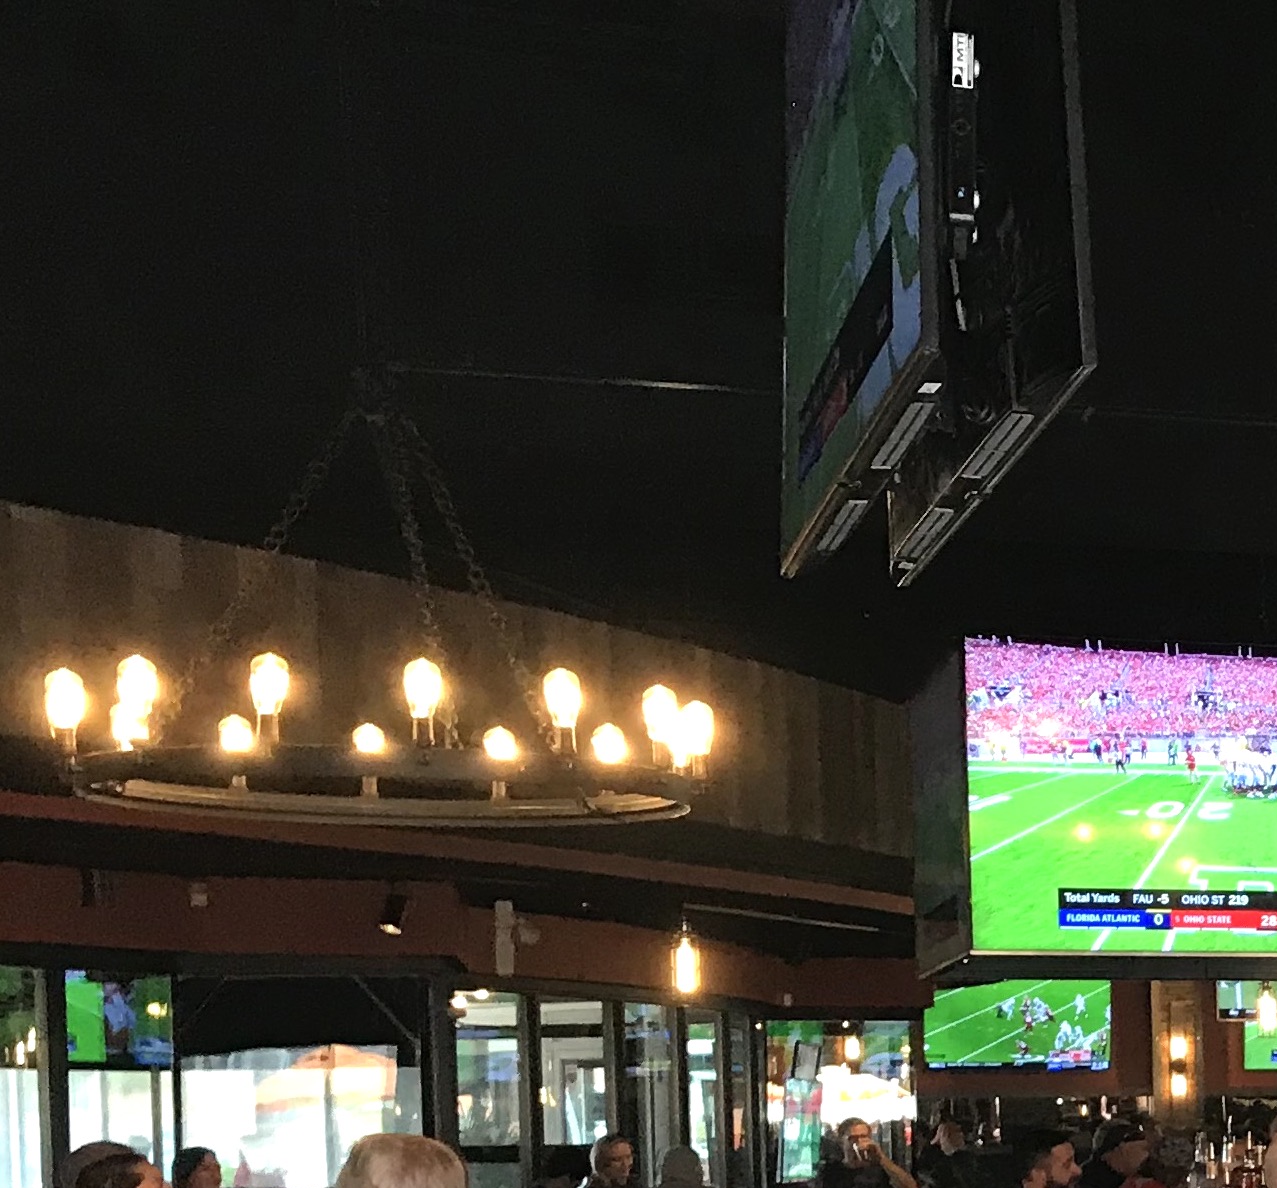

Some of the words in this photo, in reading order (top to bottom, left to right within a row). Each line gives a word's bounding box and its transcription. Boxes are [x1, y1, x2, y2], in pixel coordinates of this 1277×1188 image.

[1064, 892, 1090, 904] Total
[1091, 892, 1120, 904] Yards
[1132, 893, 1153, 905] FAU
[1156, 893, 1170, 905] -5
[1181, 894, 1209, 905] OHIO
[1211, 894, 1225, 905] ST
[1228, 894, 1250, 906] 219
[1066, 913, 1100, 923] FLORIDA
[1101, 914, 1141, 923] ATLANTIC
[1153, 913, 1164, 926] 0
[1183, 914, 1206, 924] OHIO
[1206, 915, 1232, 924] STATE
